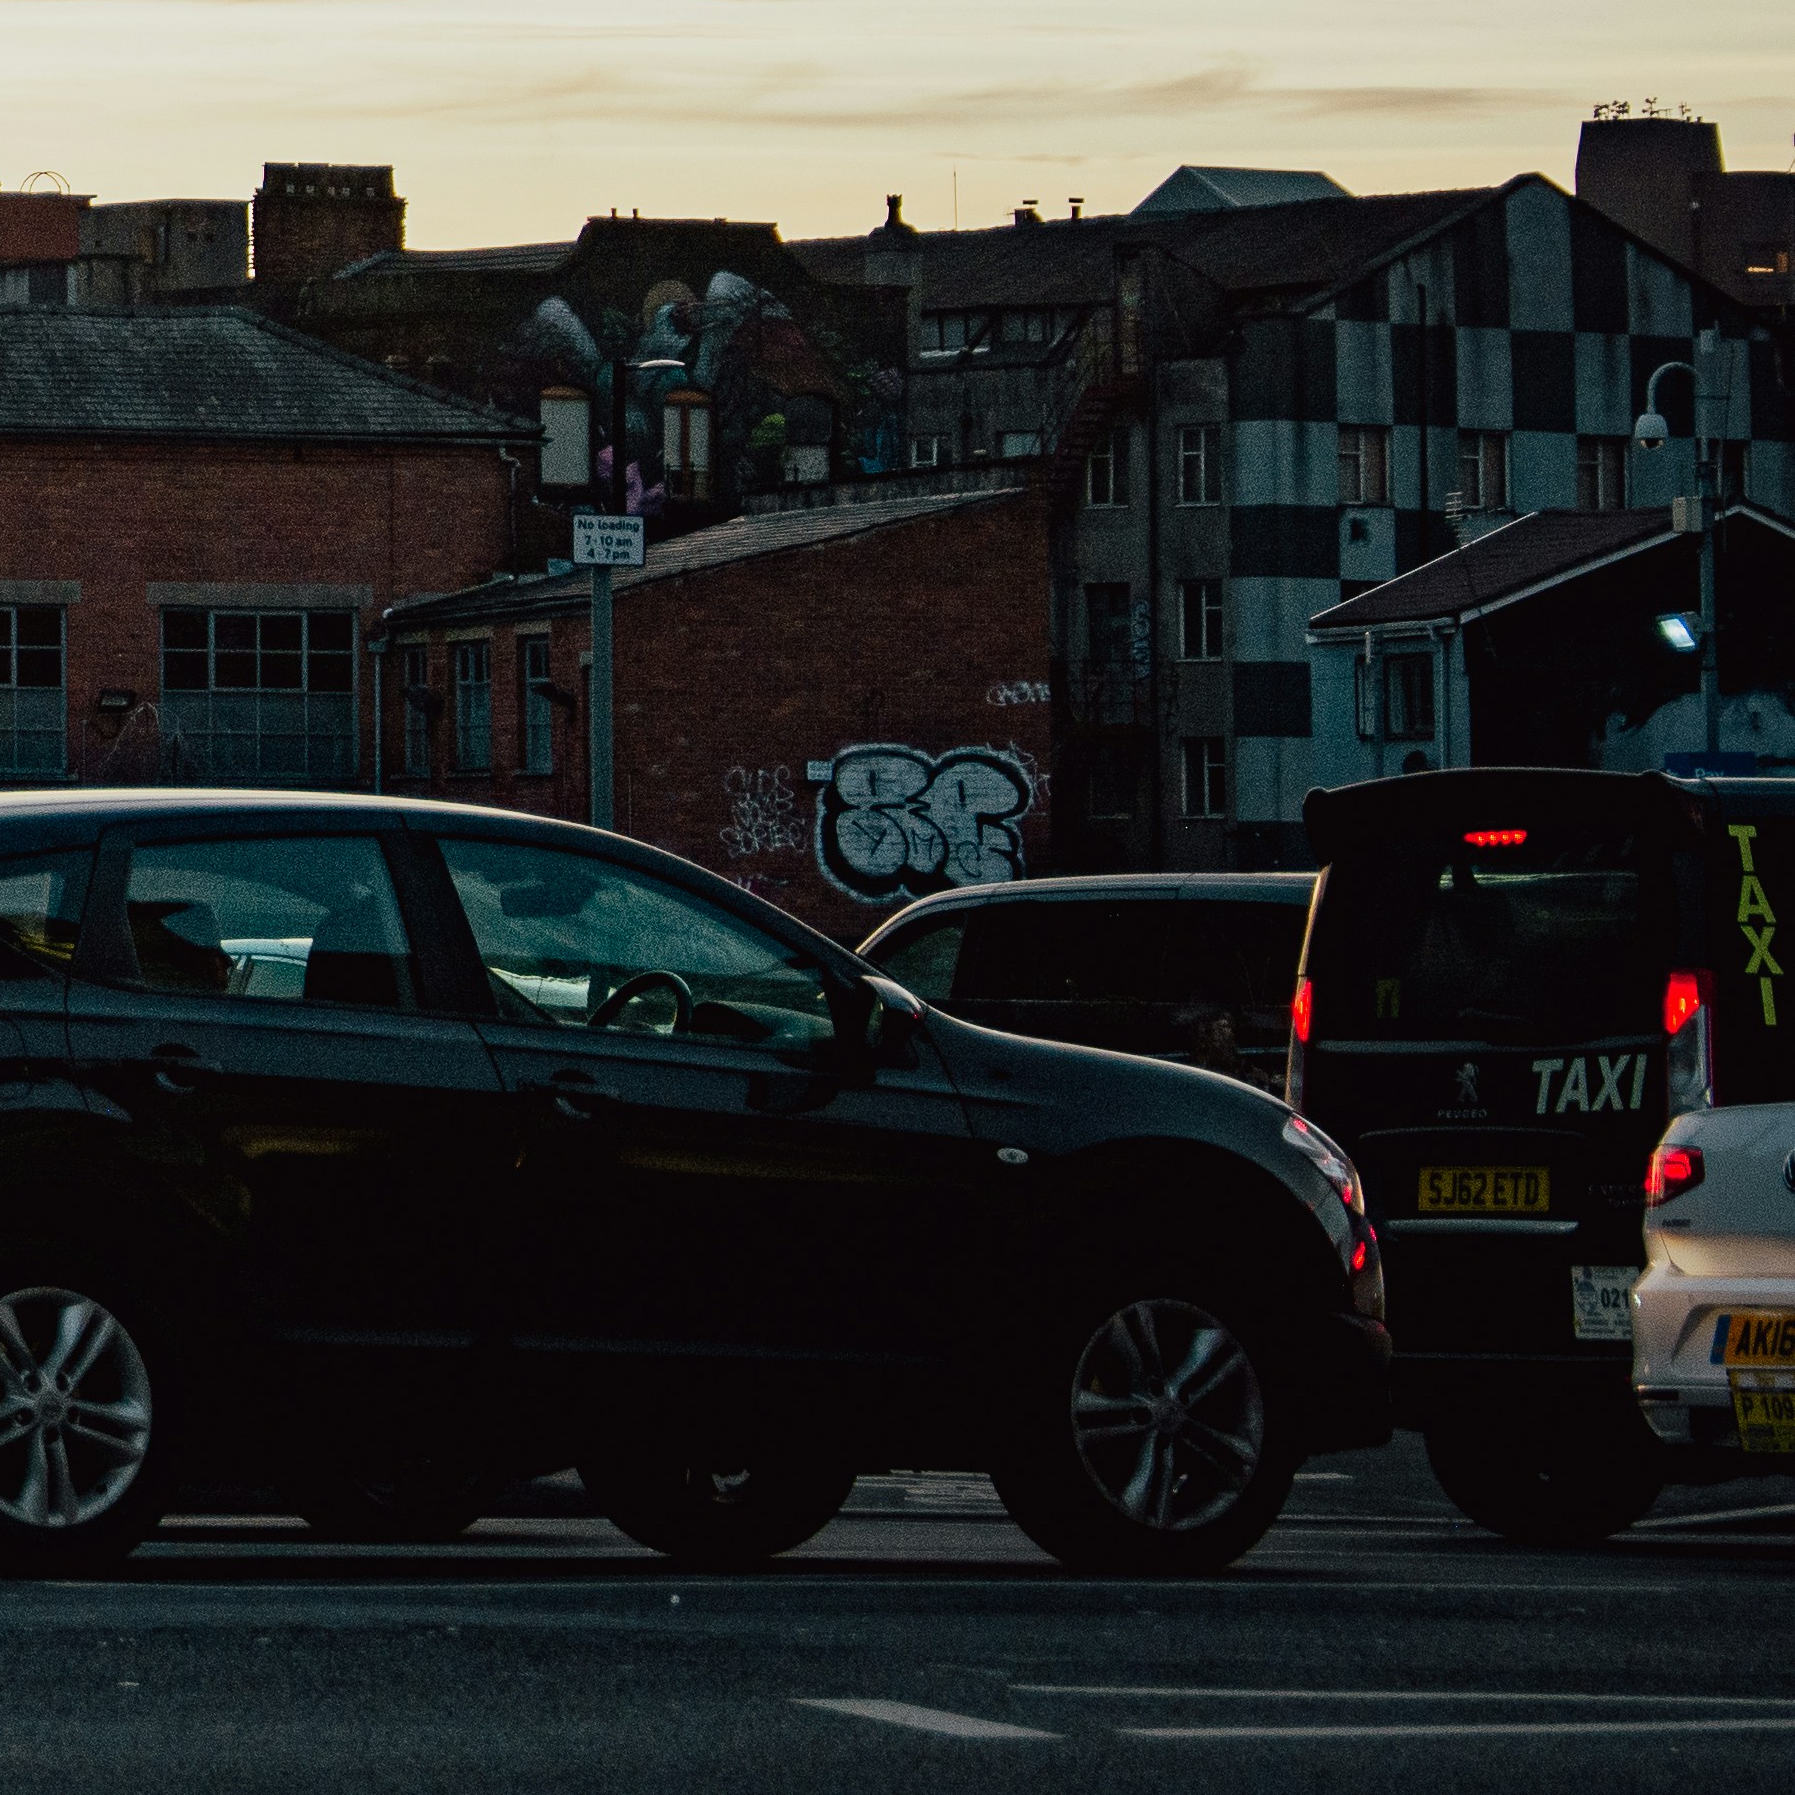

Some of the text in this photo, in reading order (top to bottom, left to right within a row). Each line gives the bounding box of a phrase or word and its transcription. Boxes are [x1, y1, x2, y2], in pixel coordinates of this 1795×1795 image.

[578, 520, 639, 532] No loading
[1726, 823, 1785, 1027] TAXI
[1531, 1053, 1648, 1116] TAXI
[1429, 1172, 1540, 1205] SJ62 ETD
[1735, 1319, 1795, 1357] AK16
